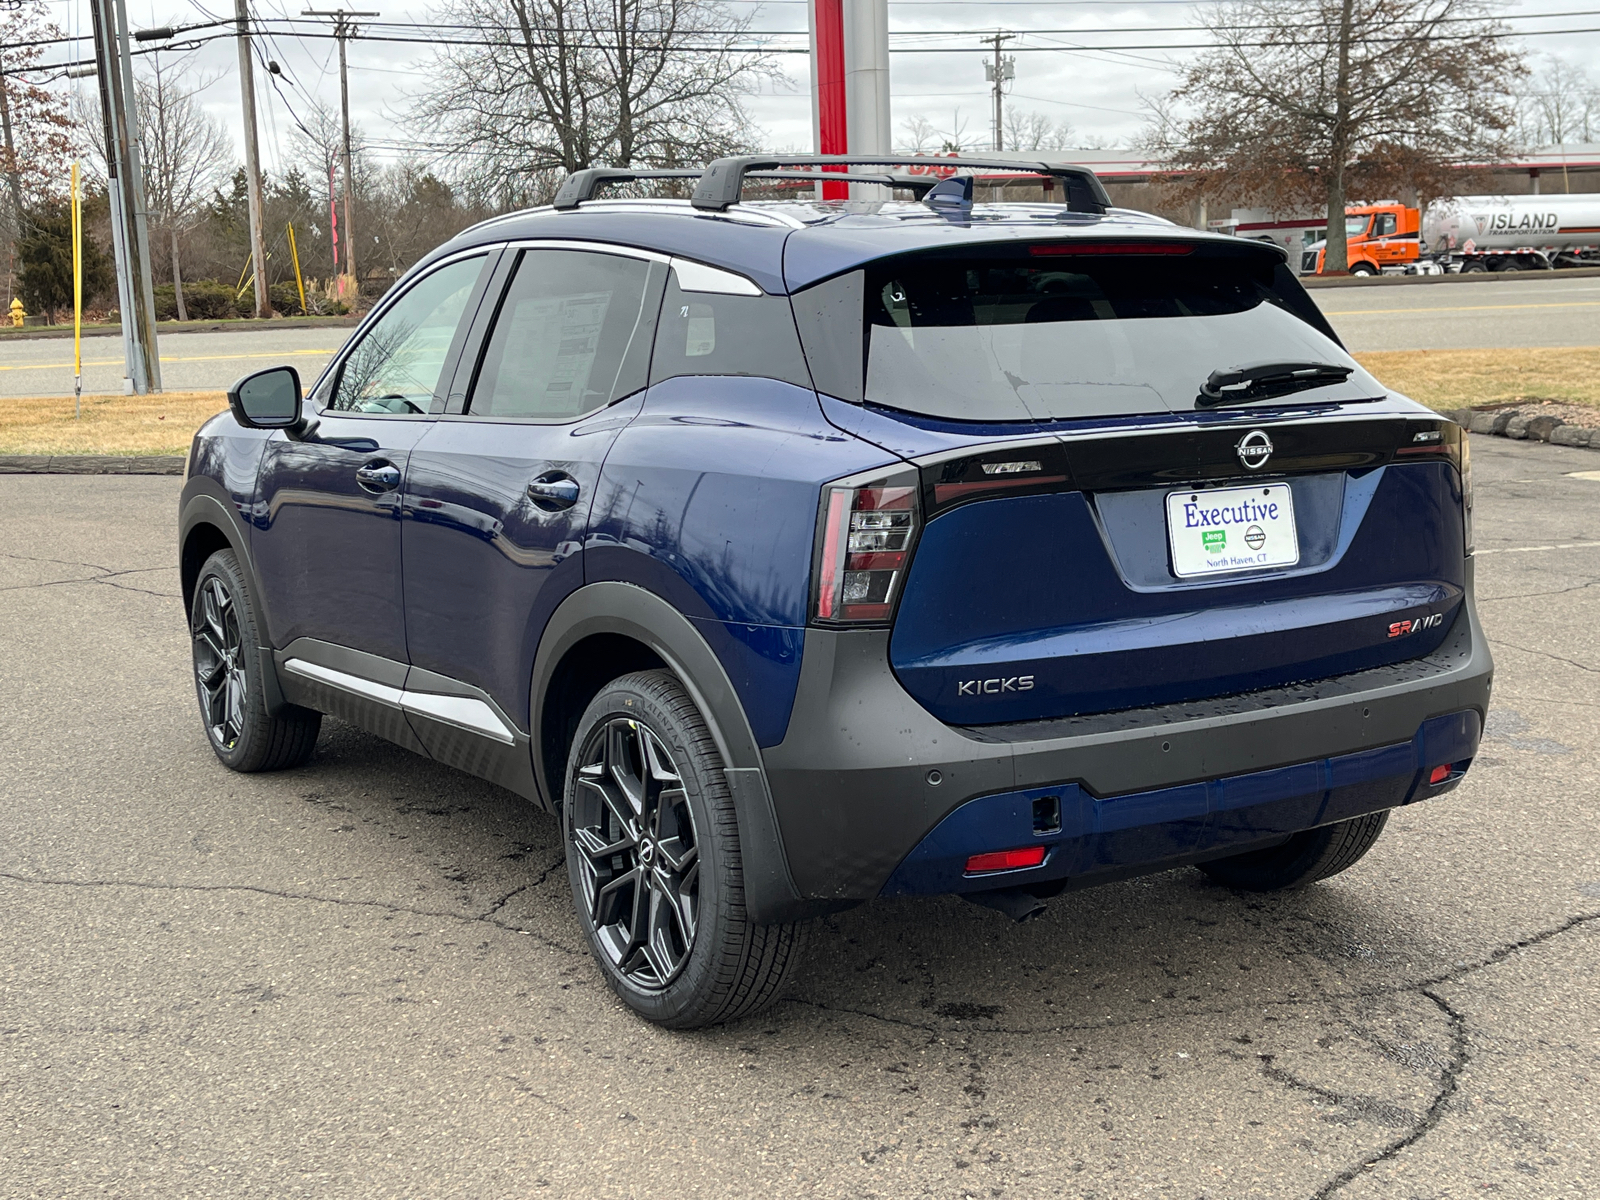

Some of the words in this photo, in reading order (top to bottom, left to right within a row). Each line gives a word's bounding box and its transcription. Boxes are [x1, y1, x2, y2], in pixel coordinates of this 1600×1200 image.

[1490, 214, 1558, 229] ISLAND
[1238, 446, 1273, 456] NISSAN
[1184, 498, 1279, 528] Executive
[1204, 532, 1223, 542] Jeep
[1206, 556, 1229, 568] North
[1230, 555, 1256, 566] Haven,
[1256, 553, 1267, 563] CT
[957, 675, 1035, 696] KICKS
